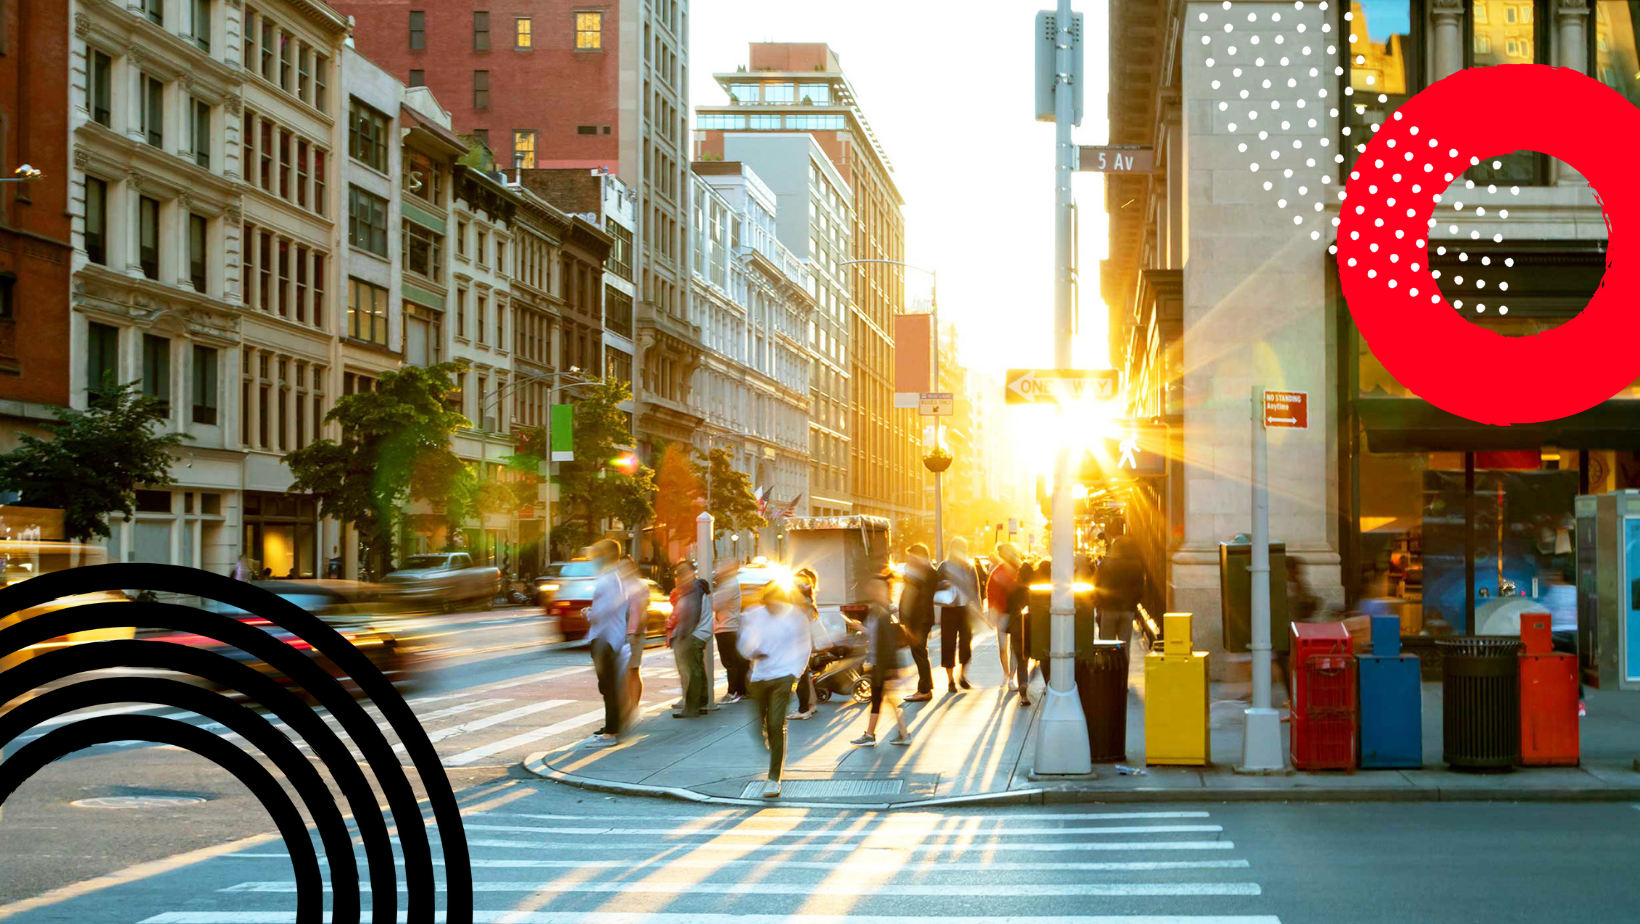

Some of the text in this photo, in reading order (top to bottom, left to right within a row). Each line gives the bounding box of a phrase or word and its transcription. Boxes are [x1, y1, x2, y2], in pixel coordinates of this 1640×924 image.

[1098, 152, 1134, 171] 5 Av
[1020, 379, 1108, 394] ONE WY
[1266, 394, 1302, 404] NO STANDING
[1267, 402, 1290, 411] Anytime
